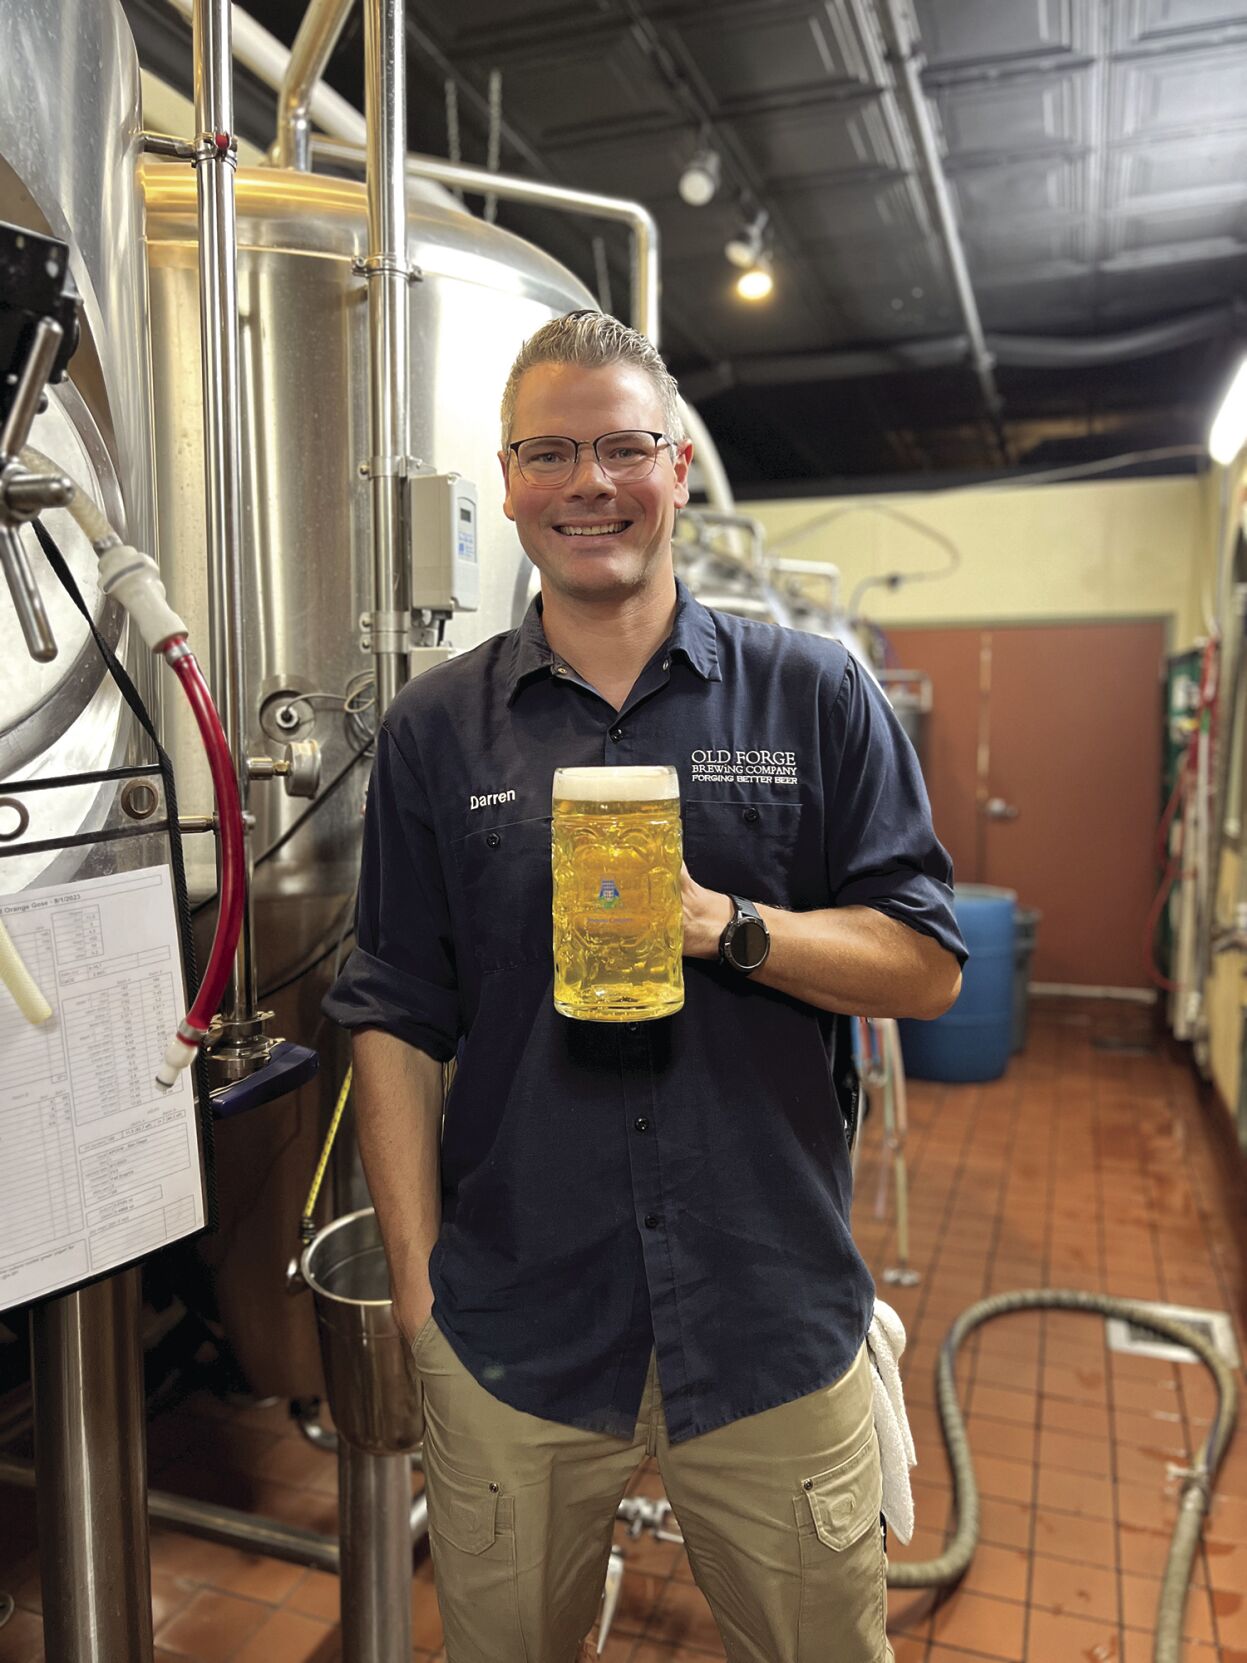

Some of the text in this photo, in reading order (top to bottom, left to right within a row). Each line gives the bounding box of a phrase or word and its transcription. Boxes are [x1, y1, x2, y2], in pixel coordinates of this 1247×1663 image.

[691, 750, 796, 765] OLD FORGE
[745, 765, 797, 776] COMPANY
[692, 774, 734, 782] FORGING
[737, 775, 772, 783] BETTER
[470, 790, 516, 810] Darren
[4, 905, 29, 913] Orange
